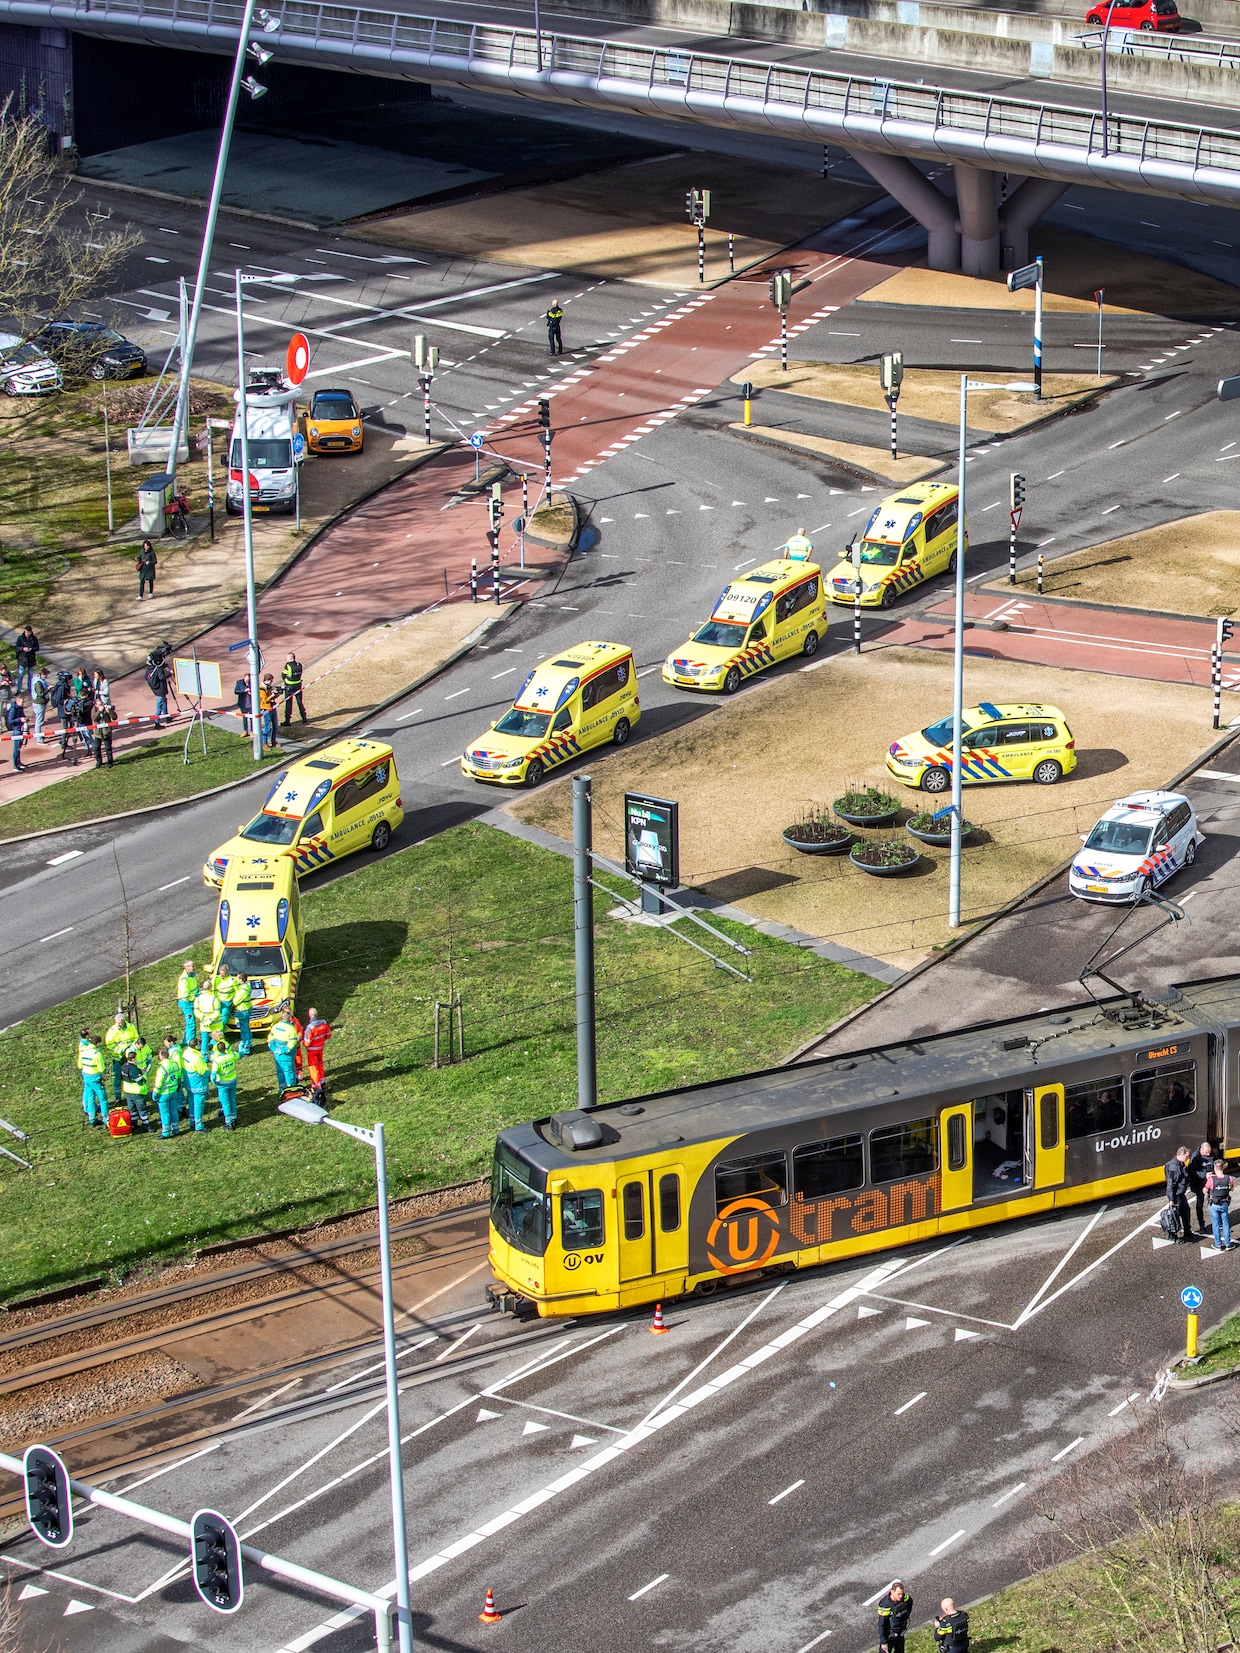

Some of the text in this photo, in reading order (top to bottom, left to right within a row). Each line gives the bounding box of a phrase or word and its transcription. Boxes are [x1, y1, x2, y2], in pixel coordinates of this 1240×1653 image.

[922, 547, 946, 563] AMBULANCE
[726, 594, 757, 604] 09120
[771, 628, 800, 646] AMBULANCE
[578, 716, 608, 735] AMBULANCE
[630, 808, 651, 820] Nu bij
[630, 816, 646, 827] KPN
[330, 811, 385, 841] AMBULANCE 09125
[1148, 1045, 1178, 1060] Utrecht CS
[1095, 1125, 1162, 1153] u-ov.info
[789, 1175, 942, 1246] tram
[584, 1253, 605, 1265] OV
